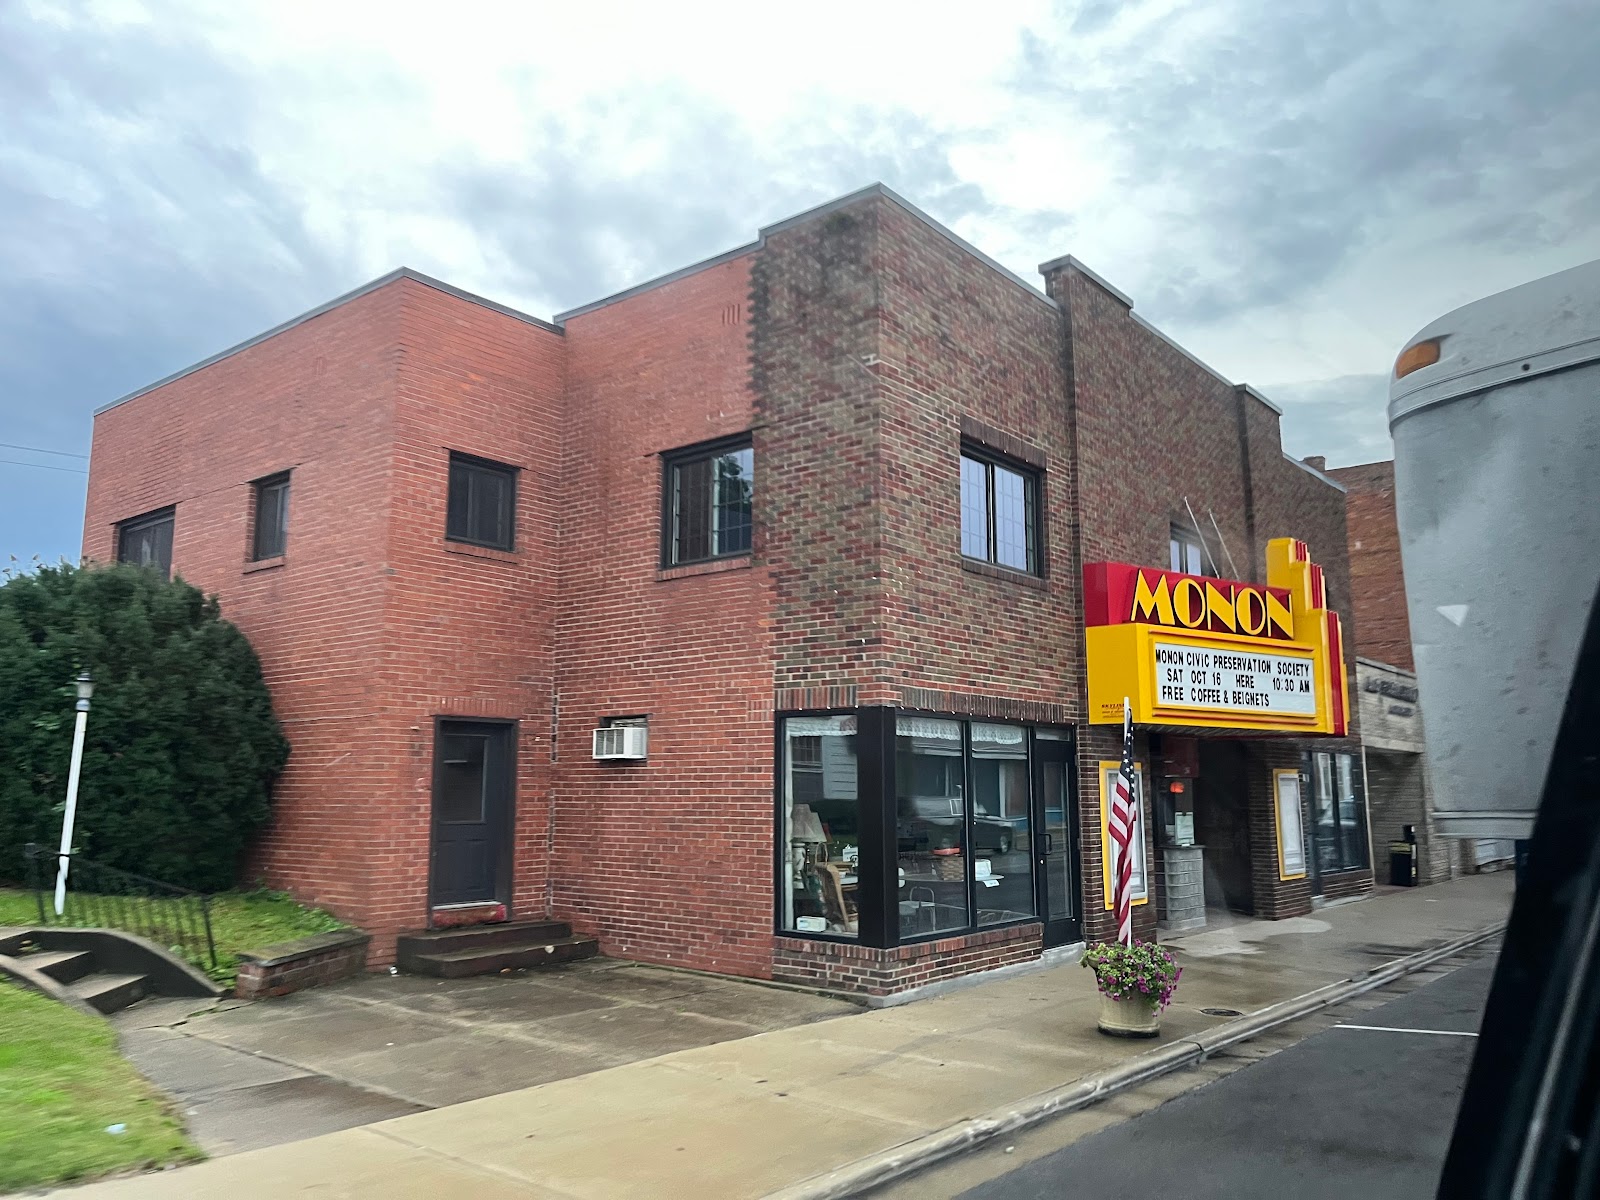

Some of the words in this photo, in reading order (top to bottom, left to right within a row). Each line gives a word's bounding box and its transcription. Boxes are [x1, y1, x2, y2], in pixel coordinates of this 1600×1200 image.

[1130, 568, 1295, 640] MONON
[1155, 649, 1184, 665] MONON
[1186, 652, 1210, 668] CIVIC
[1213, 655, 1272, 674] PRESERVATION
[1277, 661, 1310, 677] SOCIETY
[1167, 668, 1183, 683] SAT
[1190, 670, 1207, 685] OCT
[1212, 671, 1221, 686] 16
[1235, 674, 1255, 689] HERE
[1272, 677, 1295, 692] 10:30
[1299, 679, 1310, 693] AM
[1162, 685, 1184, 701] FREE
[1190, 687, 1221, 703] COFFEE
[1223, 689, 1229, 704] &
[1232, 690, 1270, 707] BEIGNETS
